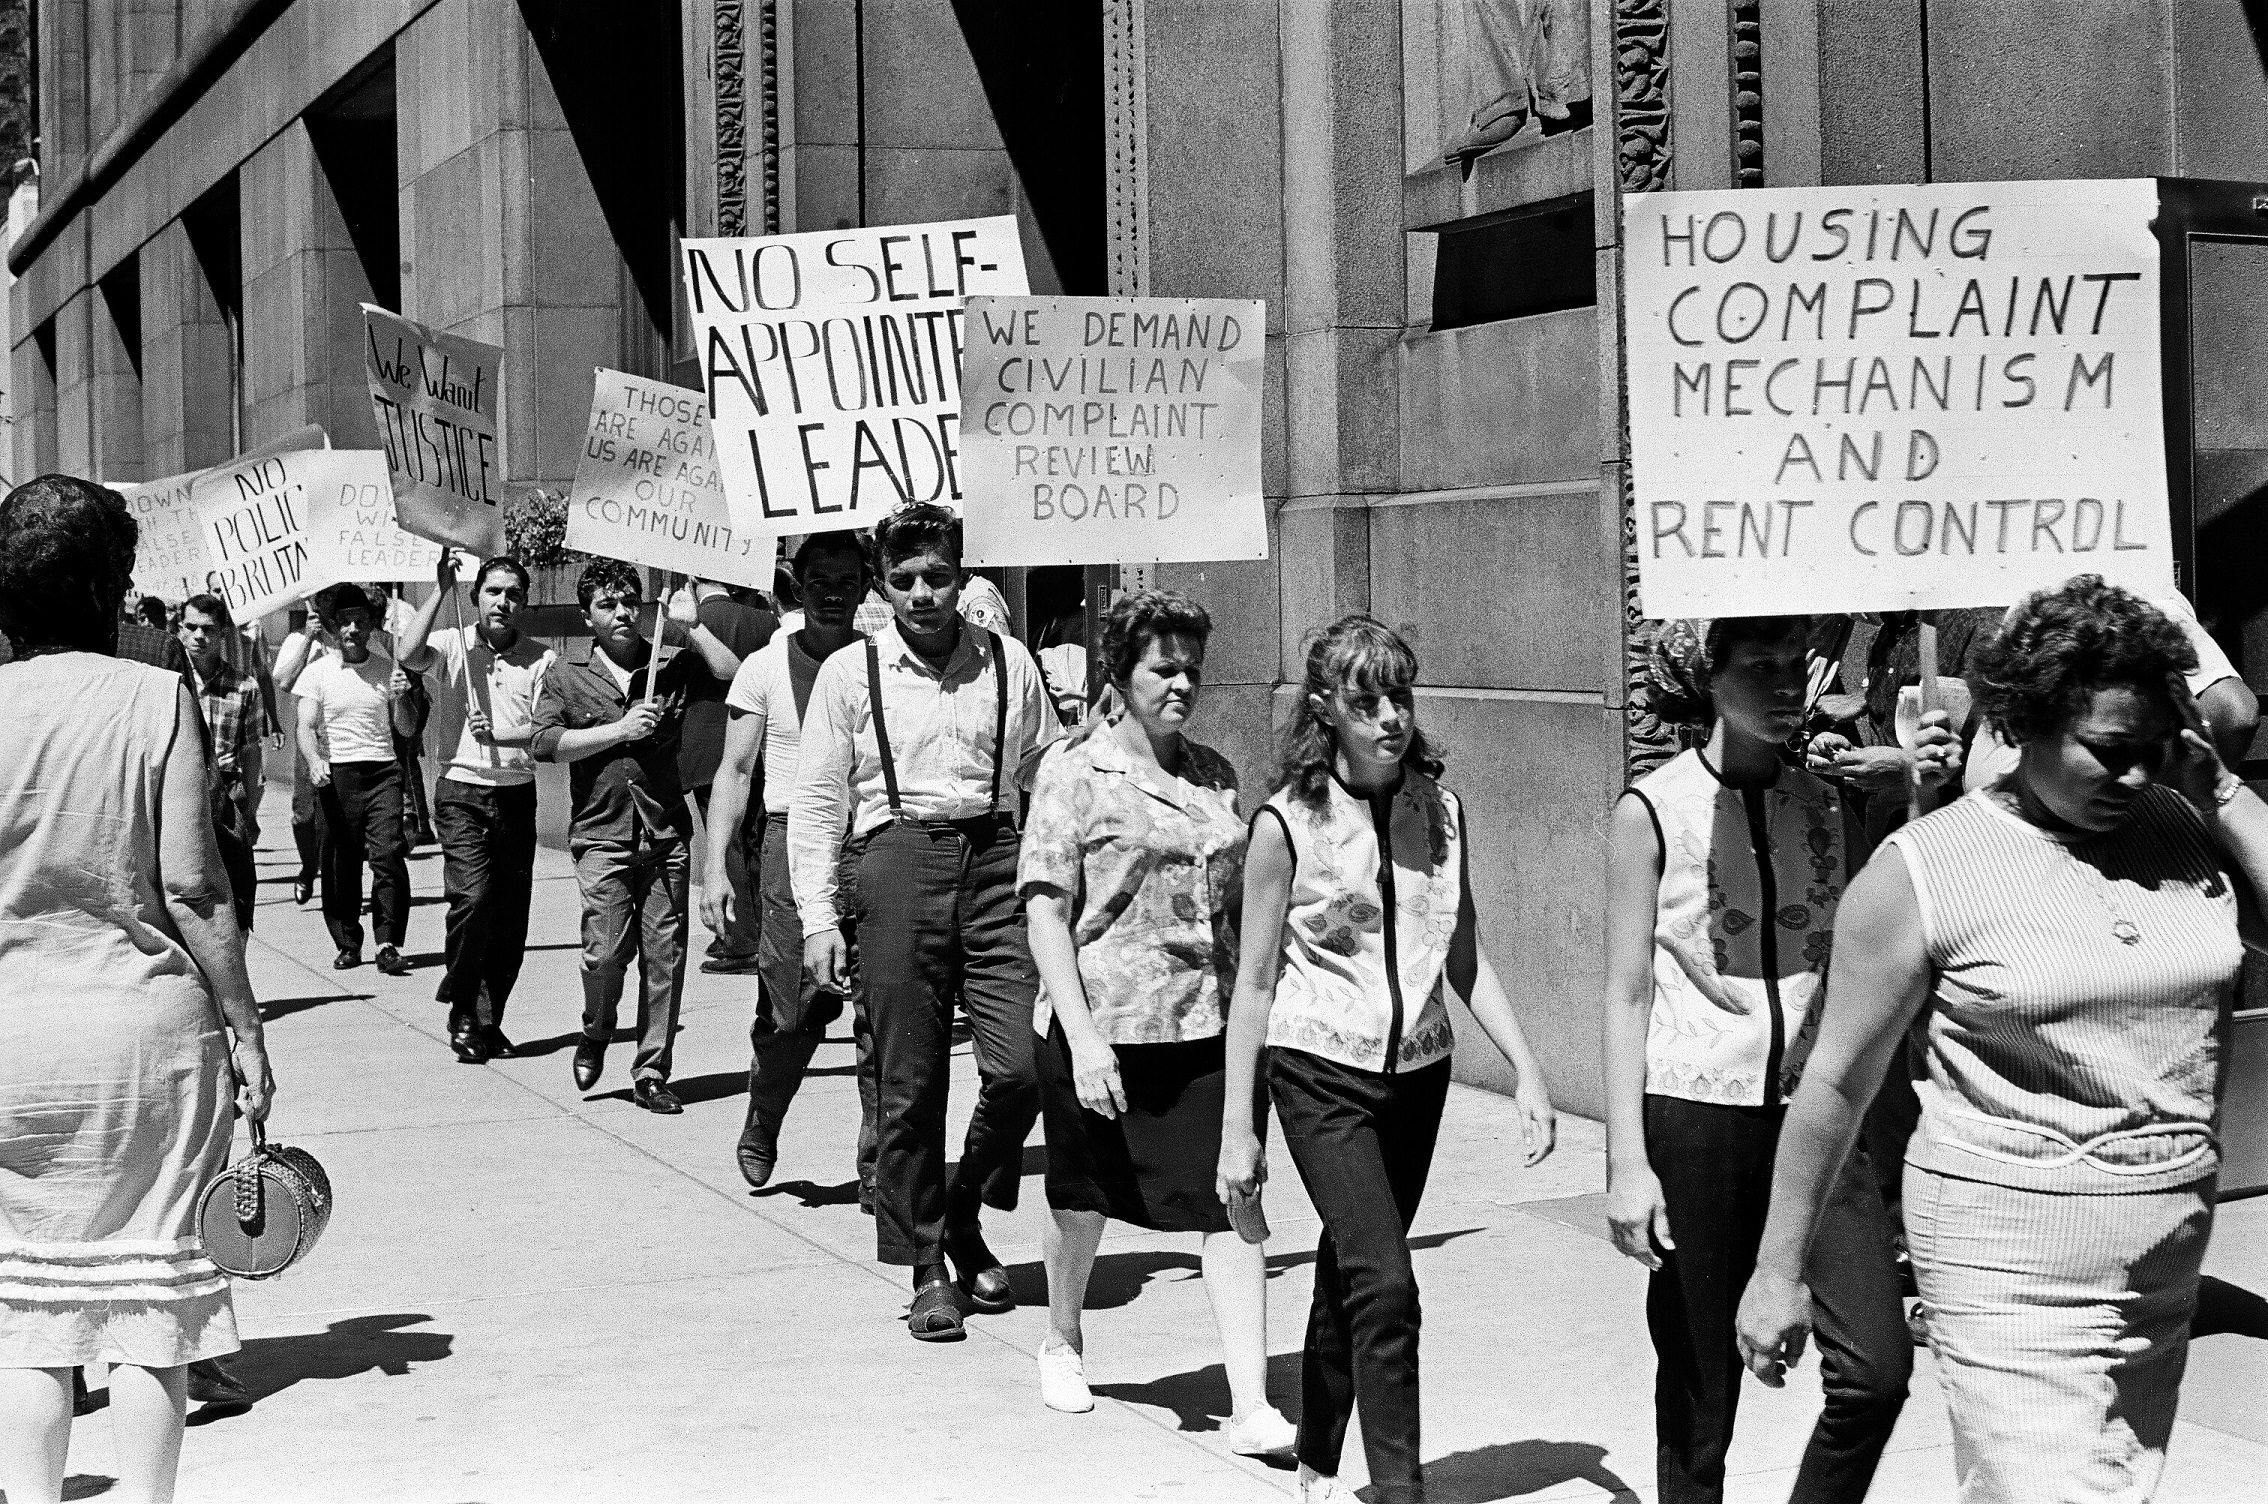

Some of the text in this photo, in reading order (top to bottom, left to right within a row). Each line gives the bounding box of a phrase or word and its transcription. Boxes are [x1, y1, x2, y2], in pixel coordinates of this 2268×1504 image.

[1660, 204, 1993, 267] HOUSING
[687, 230, 998, 314] NO SELF-
[982, 309, 1242, 352] WE DEMAND
[1667, 271, 2143, 346] COMPLAINT
[368, 322, 487, 414] We Want
[707, 308, 965, 420] APPOINTE
[997, 356, 1209, 395] CIVILIAN
[1673, 351, 2116, 418] MECHANISM
[594, 409, 715, 460] ARE AGAI
[623, 385, 706, 428] THOSE
[984, 401, 1219, 440] COMPLAINT
[234, 457, 286, 501] NO
[373, 393, 497, 507] JUSTICE
[586, 435, 616, 462] US
[623, 447, 667, 478] ARE
[747, 412, 963, 519] LEADE
[1015, 443, 1156, 479] REVIEW
[1774, 428, 1940, 486] AND
[214, 484, 303, 561] POLIC
[635, 479, 697, 514] OUR
[1033, 482, 1180, 522] BOARD
[1650, 497, 2149, 560] RENT CONTROL
[220, 540, 308, 609] BRUTA
